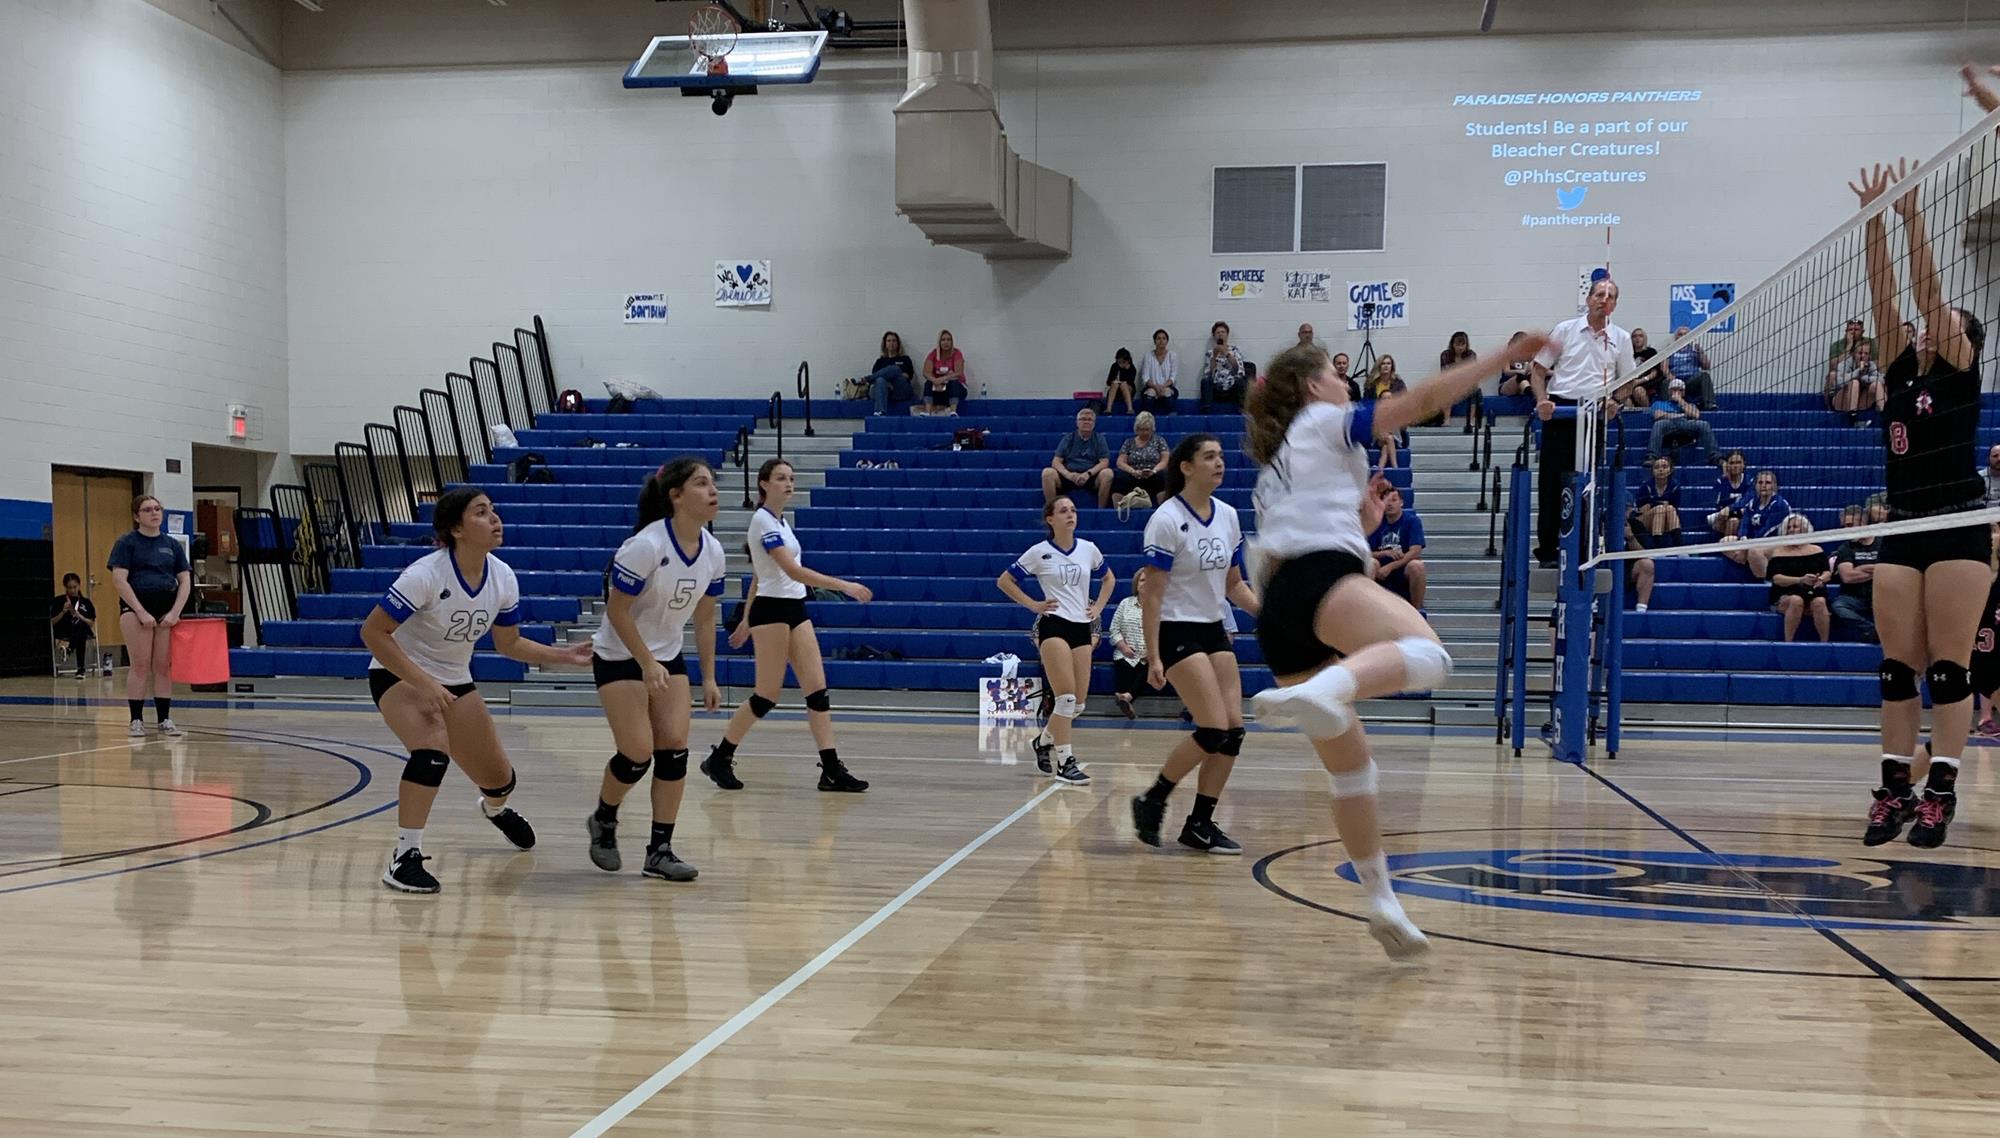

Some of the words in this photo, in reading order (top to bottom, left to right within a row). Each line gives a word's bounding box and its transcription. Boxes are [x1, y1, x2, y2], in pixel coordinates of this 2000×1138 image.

[1453, 93, 1537, 106] PARADISE
[1537, 91, 1609, 104] HONORS
[1611, 90, 1702, 103] PANTHERS
[1465, 119, 1547, 136] Students!
[1553, 120, 1575, 135] Be
[1579, 122, 1590, 134] a
[1594, 120, 1630, 137] part
[1635, 118, 1655, 133] of
[1658, 121, 1689, 133] our
[1491, 142, 1566, 158] Bleacher
[1570, 141, 1661, 157] Creatures!
[1504, 168, 1647, 186] @PhhsCreatures
[1522, 213, 1621, 227] #pantherpride
[1672, 285, 1696, 301] PASS
[1691, 299, 1710, 315] SET
[1889, 421, 1909, 455] 8
[1198, 537, 1228, 571] 23
[1059, 563, 1082, 586] 17
[668, 579, 697, 611] 5
[444, 609, 489, 642] 26
